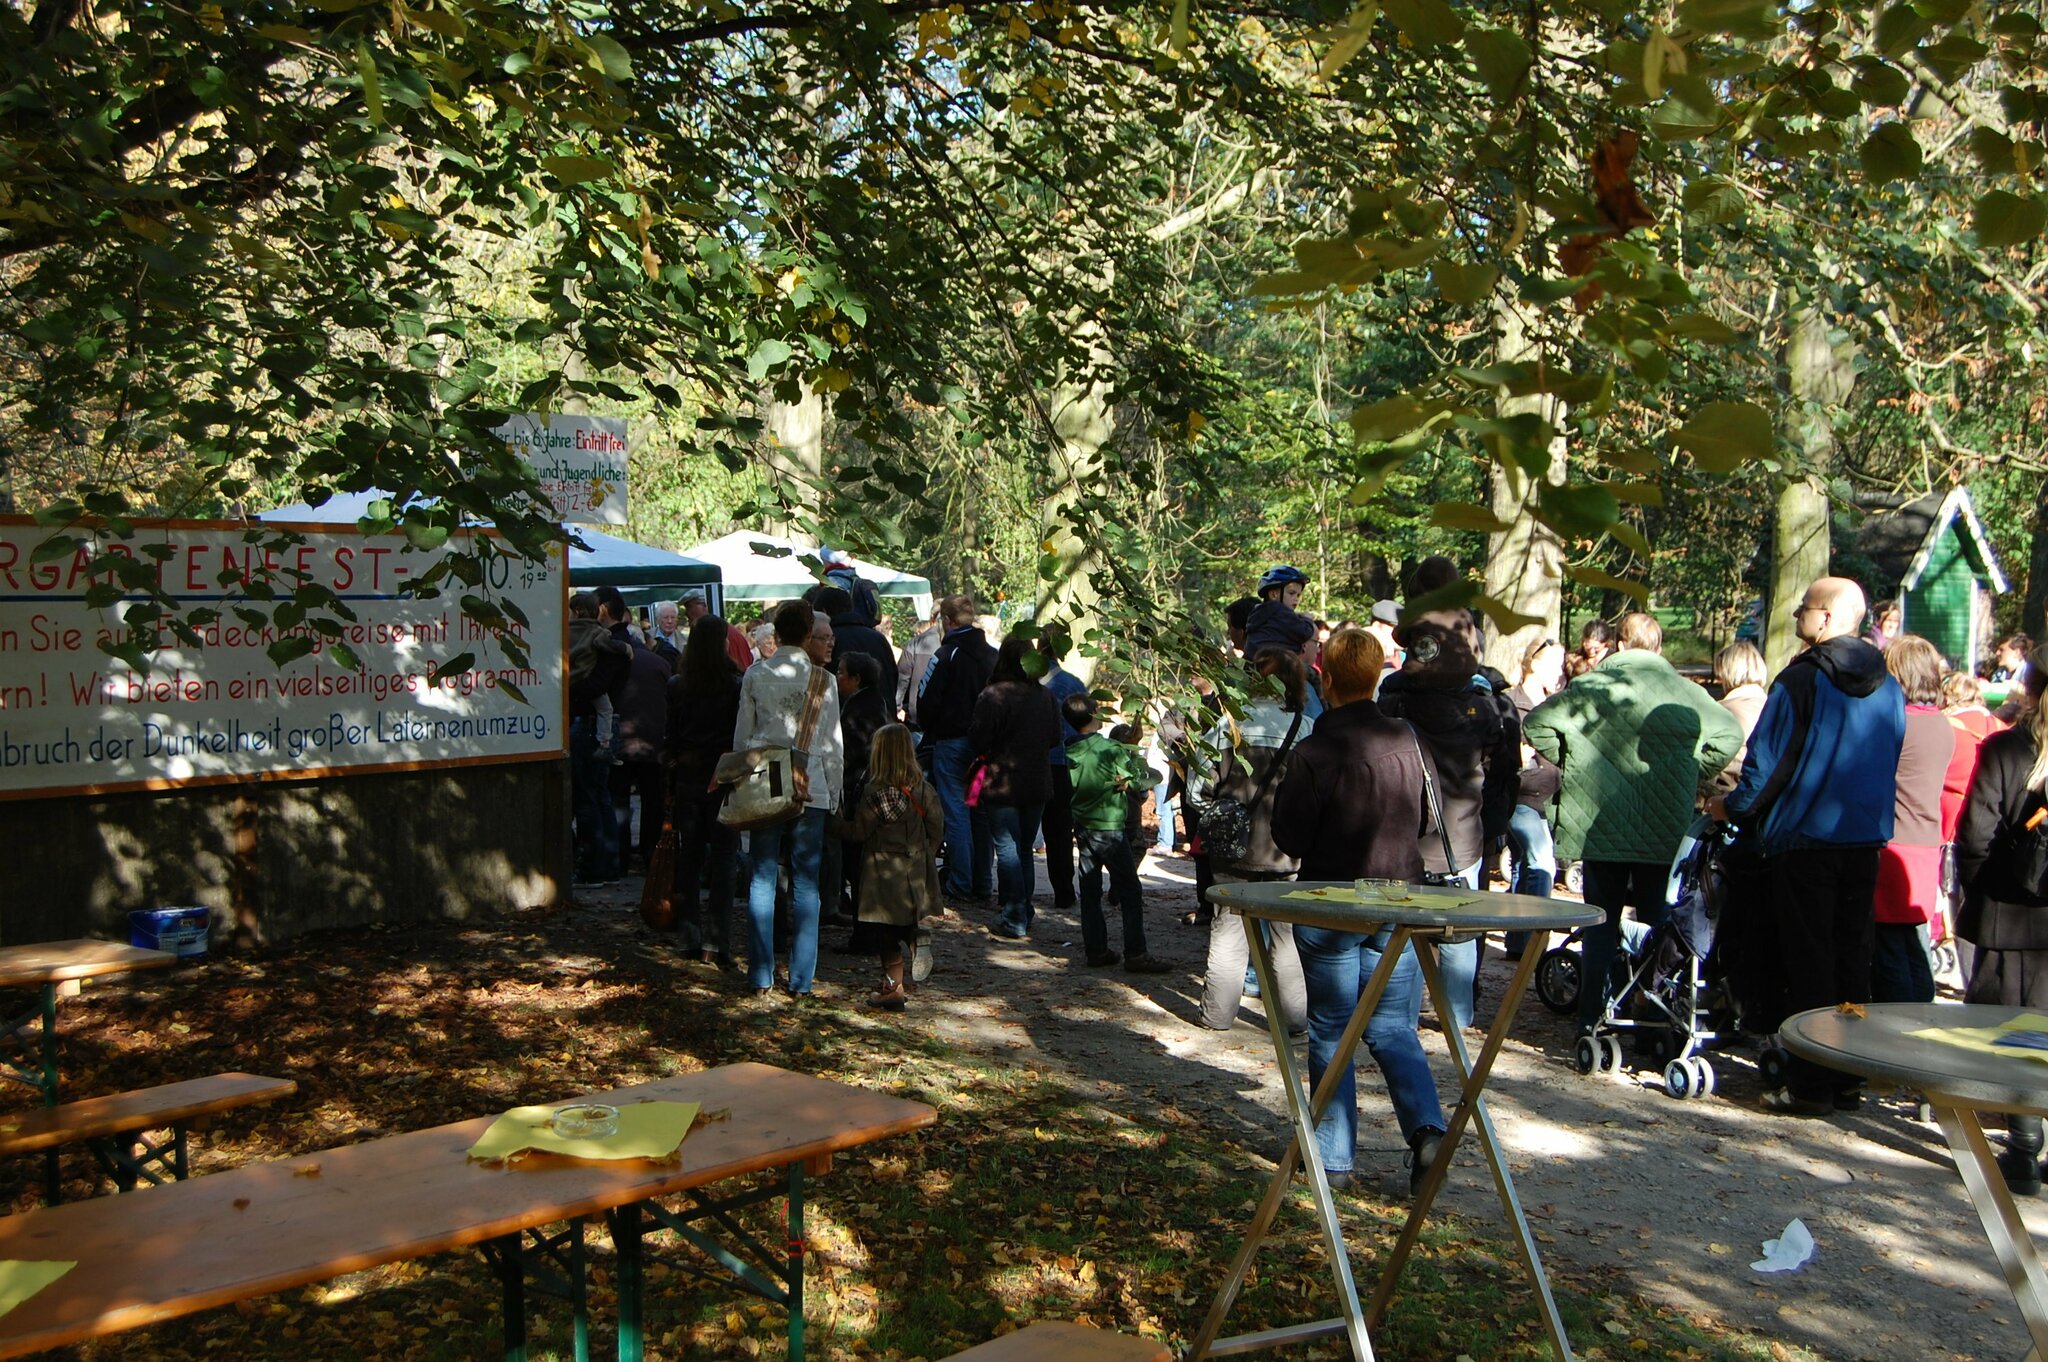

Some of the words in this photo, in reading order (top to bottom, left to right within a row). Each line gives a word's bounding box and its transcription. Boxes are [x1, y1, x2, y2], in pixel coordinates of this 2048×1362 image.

[515, 427, 529, 445] bis
[576, 429, 607, 452] Eintritt
[609, 431, 626, 454] frei
[540, 460, 559, 479] und
[562, 459, 626, 483] Jugendliche:
[31, 614, 82, 652] Sie
[413, 611, 449, 642] mit
[70, 671, 117, 706] Wir
[128, 668, 219, 704] bieten
[228, 672, 268, 699] ein
[276, 663, 417, 702] vielseitiges
[426, 660, 542, 696] Pogramm.
[0, 726, 80, 768] bruch
[89, 725, 134, 762] der
[143, 716, 281, 759] Dunkelheit
[288, 711, 371, 758] großer
[377, 710, 551, 744] Laternenumzug.
